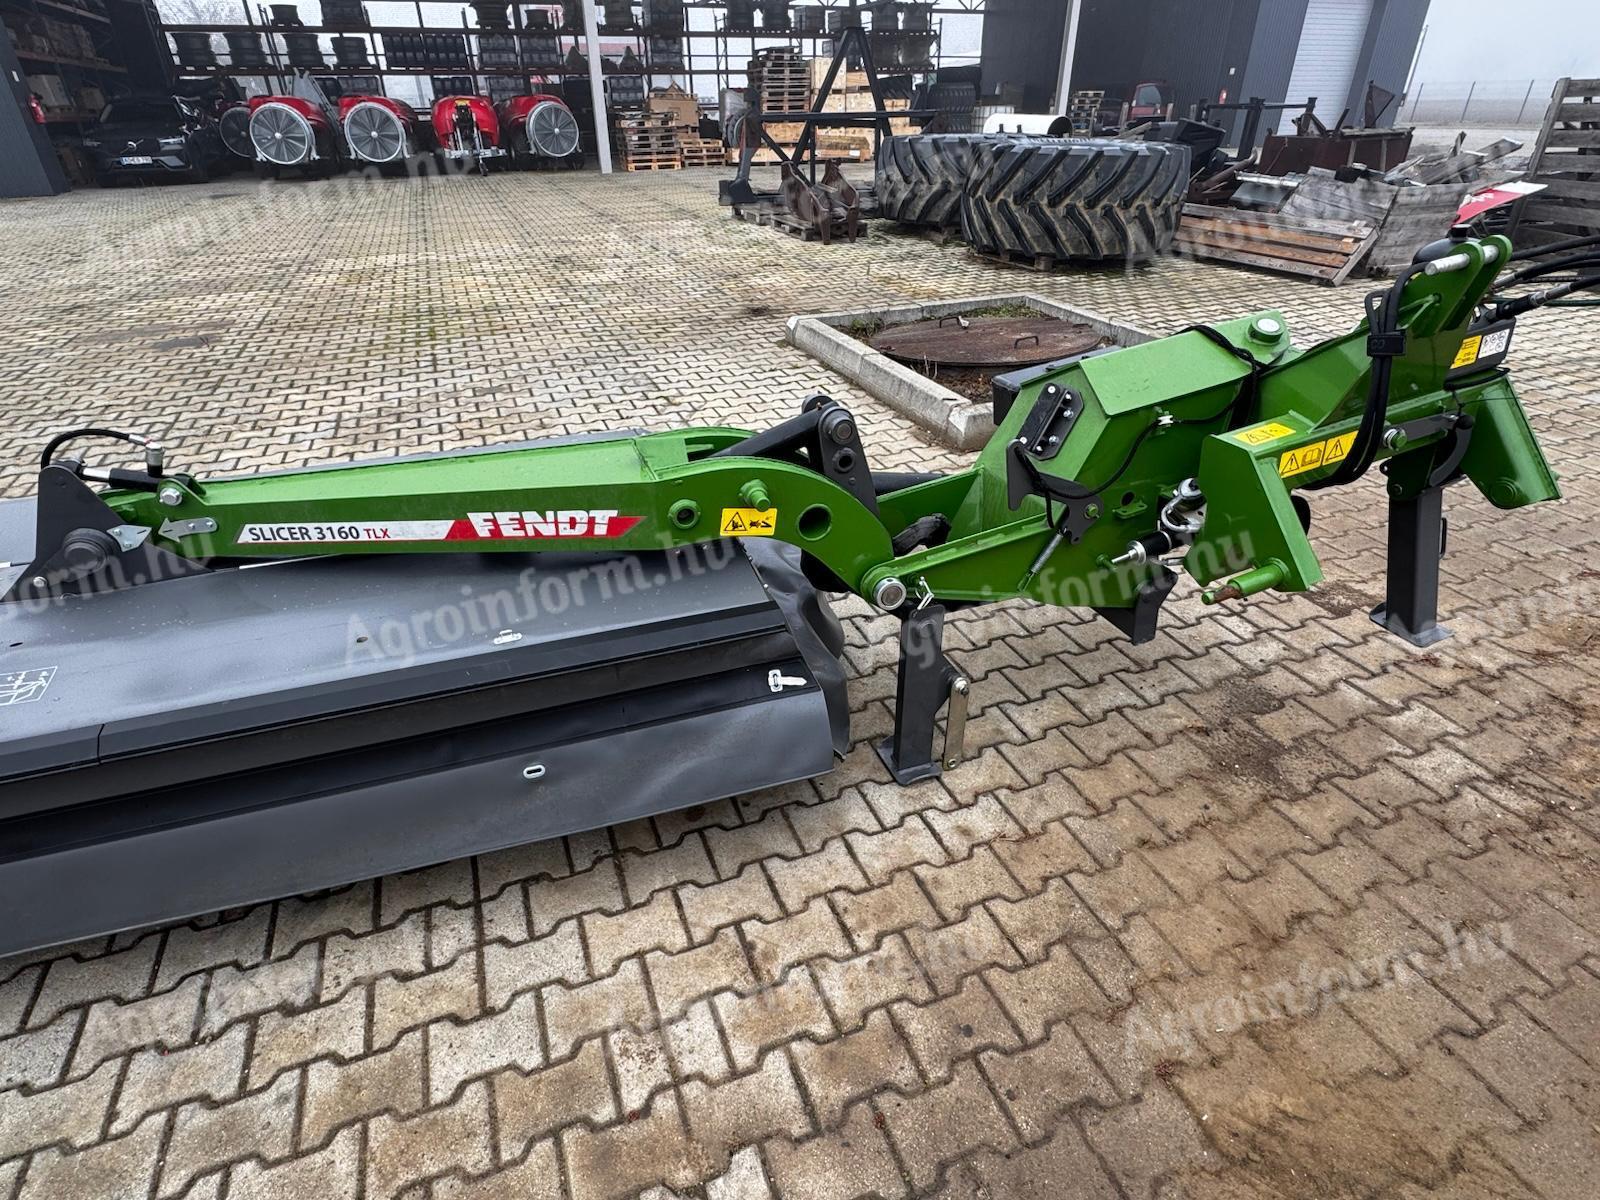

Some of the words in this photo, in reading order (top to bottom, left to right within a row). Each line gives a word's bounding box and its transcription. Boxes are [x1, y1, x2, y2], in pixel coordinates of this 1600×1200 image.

[248, 526, 312, 541] SLICER
[313, 525, 360, 541] 3160
[363, 528, 391, 539] TLX
[466, 510, 618, 537] FENDT
